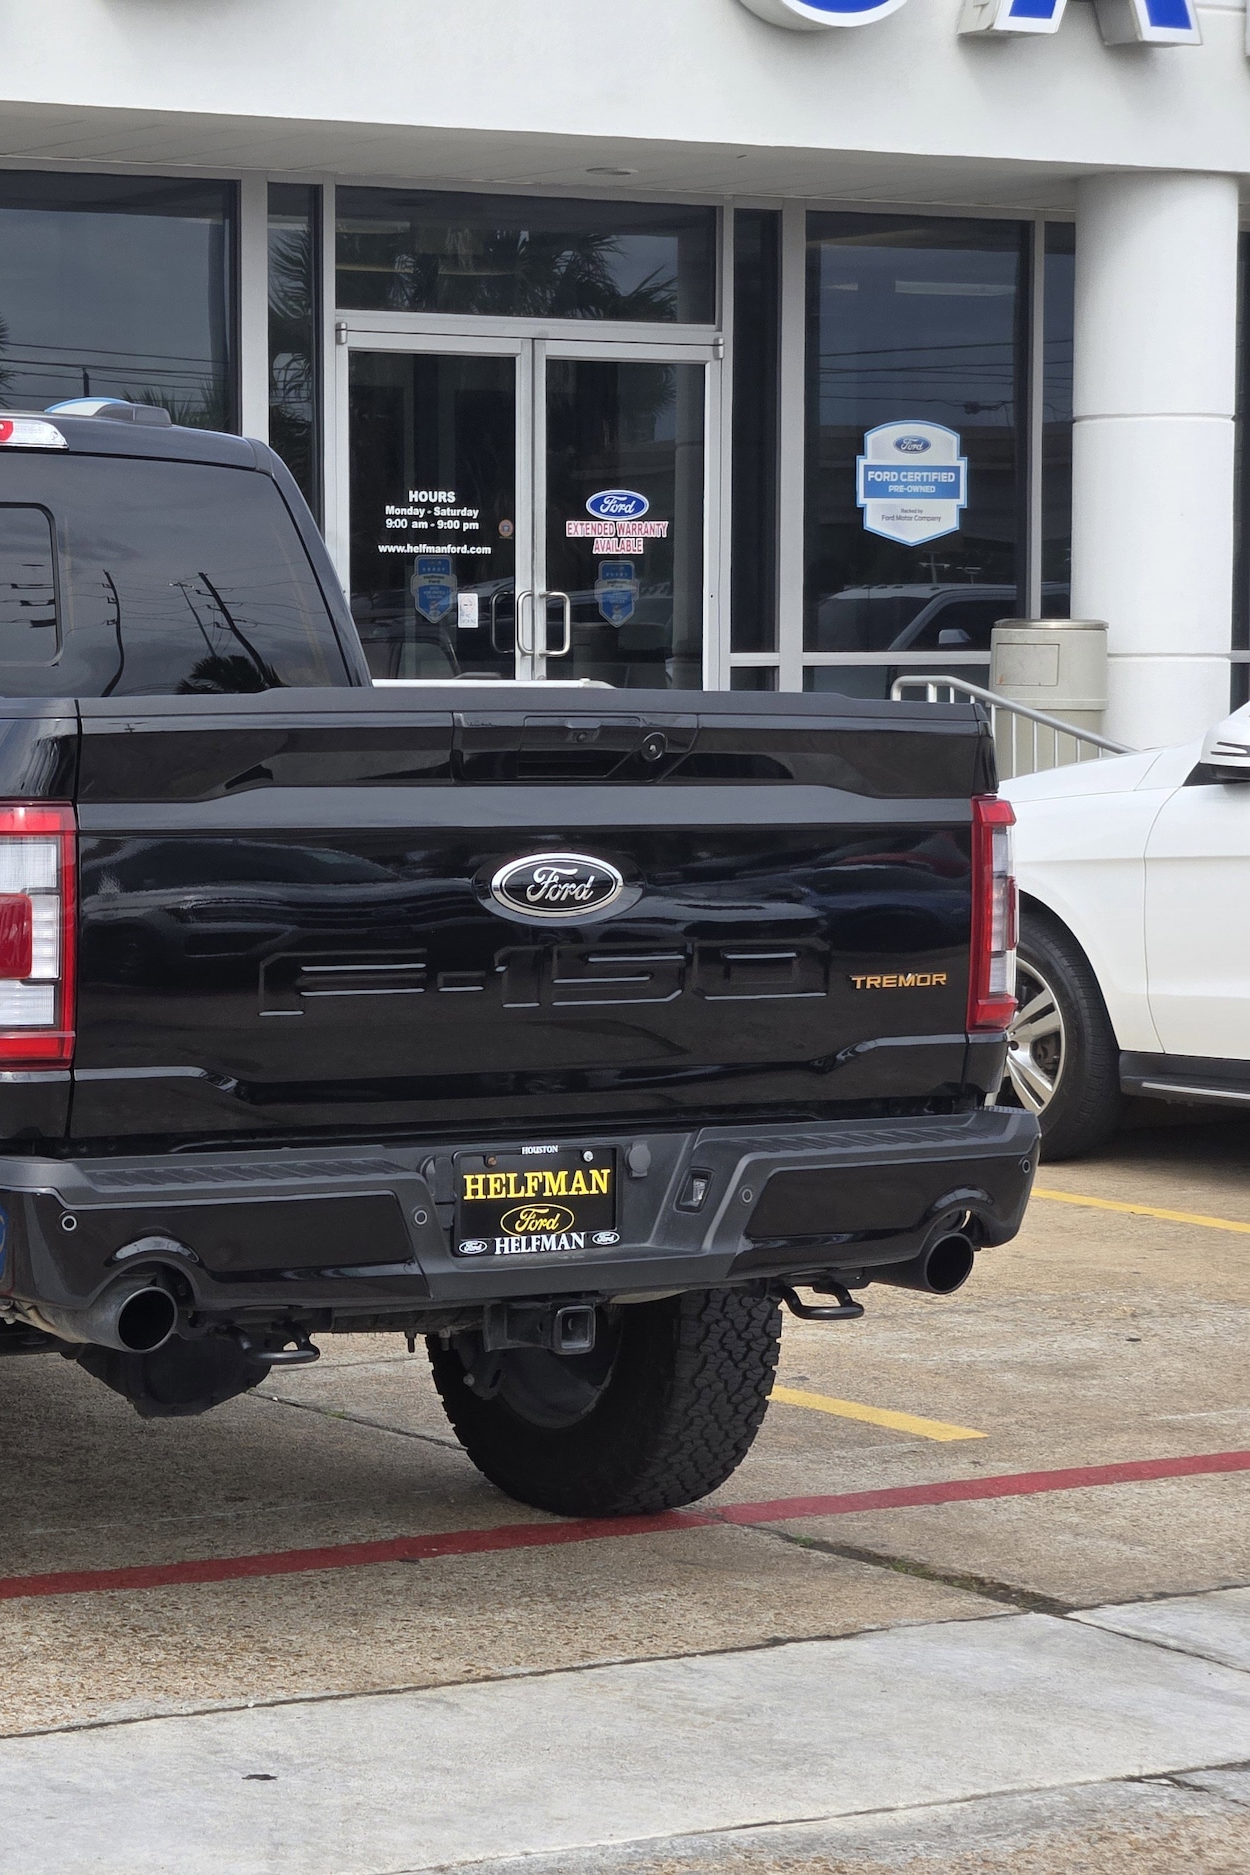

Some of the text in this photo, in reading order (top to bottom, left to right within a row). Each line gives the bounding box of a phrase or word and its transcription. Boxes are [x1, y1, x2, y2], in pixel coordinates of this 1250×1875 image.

[901, 438, 924, 451] Ford
[867, 471, 956, 483] FORD CERTIFIED
[408, 490, 456, 503] HOURS
[888, 485, 936, 493] PRE-OWNED
[385, 505, 426, 518] Monday
[433, 506, 479, 519] Saturday
[599, 495, 636, 514] Ford
[385, 519, 408, 529] 9:00
[411, 520, 428, 529] am
[437, 519, 460, 530] 9:00
[462, 521, 479, 532] pm
[566, 521, 668, 537] EXTENDED WARRANTY
[378, 543, 491, 555] www.helfmanford.com
[593, 538, 643, 554] AVAILABLE
[526, 866, 595, 903] Ford
[258, 938, 831, 1016] F-150
[850, 972, 947, 989] TREMOR
[521, 1145, 559, 1155] HOUSTON
[463, 1169, 611, 1200] HELFMAN
[514, 1208, 561, 1233] Ford
[494, 1231, 587, 1255] HELFMAN
